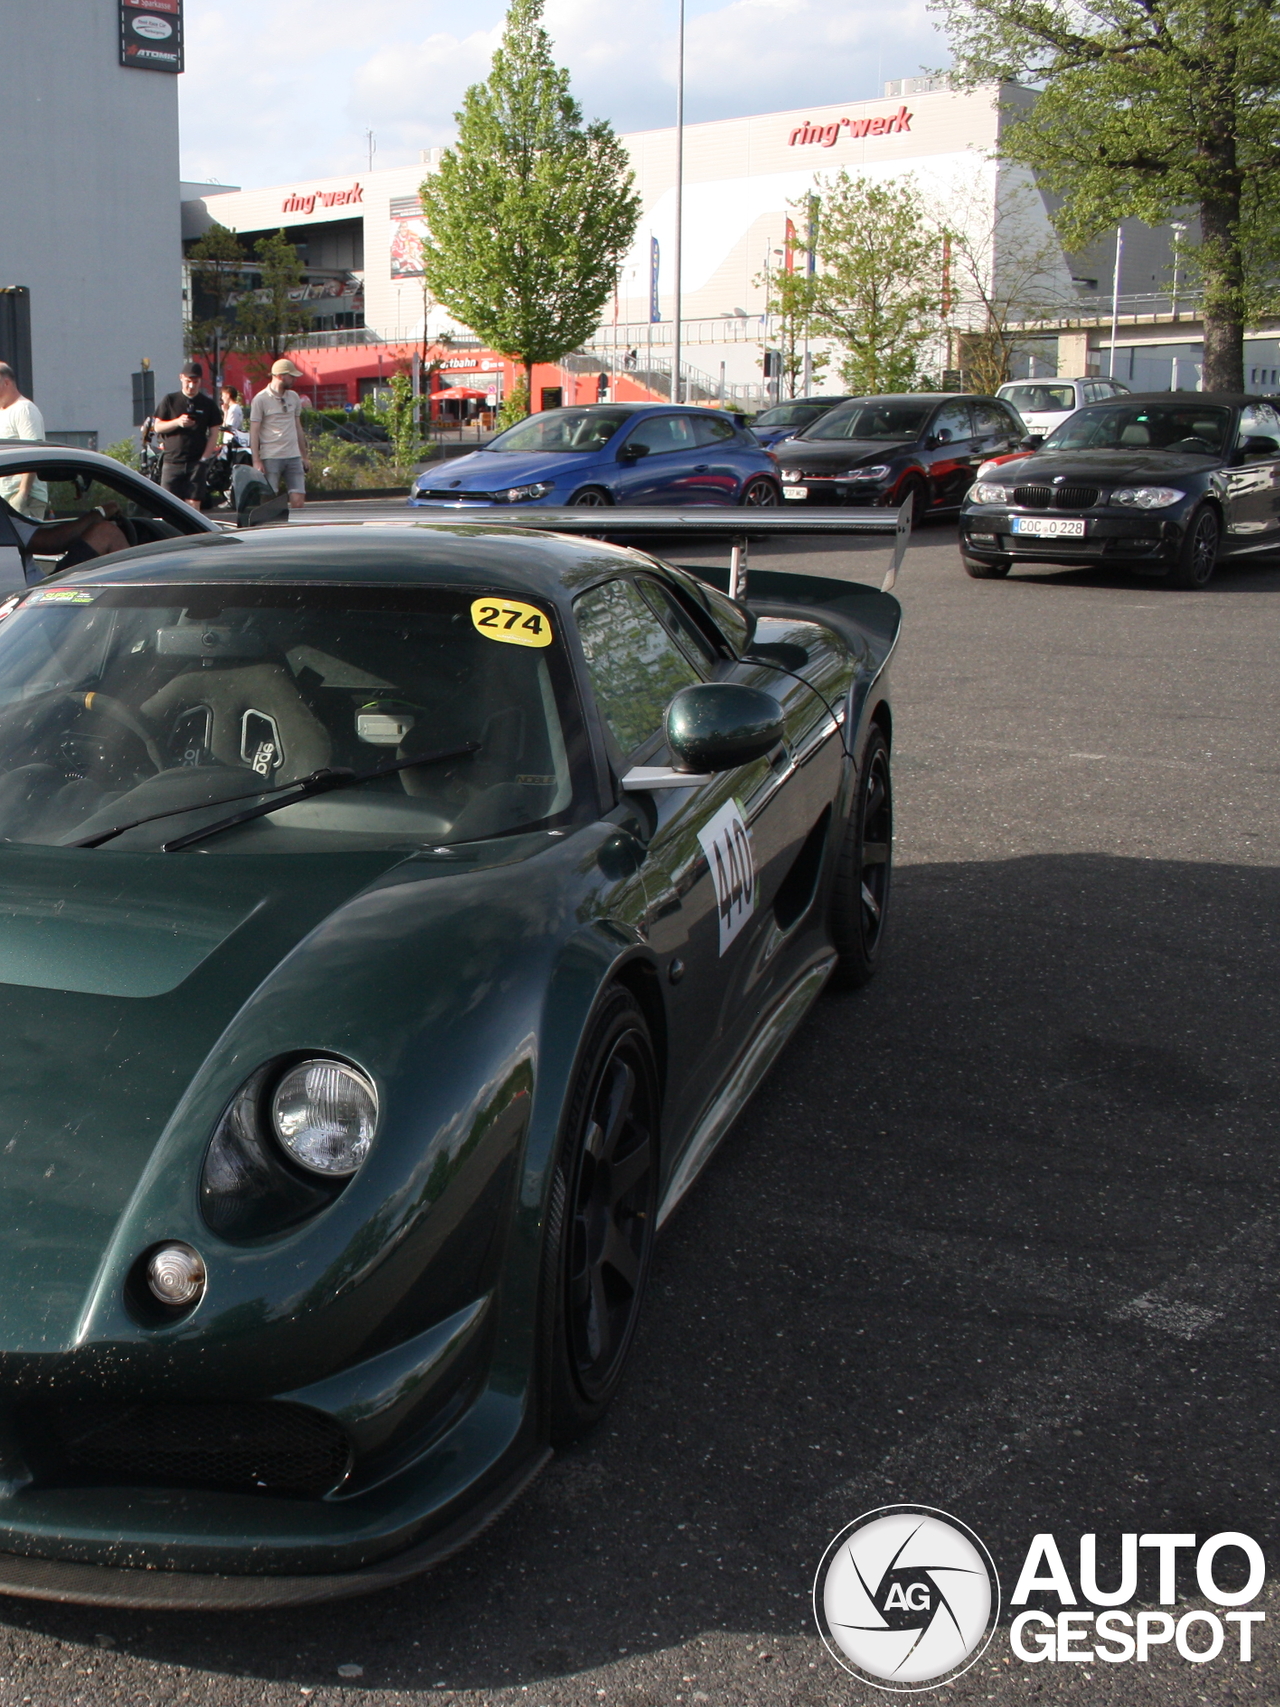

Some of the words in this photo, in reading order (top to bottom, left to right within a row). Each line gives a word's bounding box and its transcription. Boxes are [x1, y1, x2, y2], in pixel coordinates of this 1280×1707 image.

[141, 0, 171, 10] Sparkasse
[136, 49, 178, 61] ATOMIC
[1019, 520, 1042, 532] COC
[1060, 522, 1083, 534] 228
[478, 606, 543, 635] 274
[713, 818, 753, 930] 440
